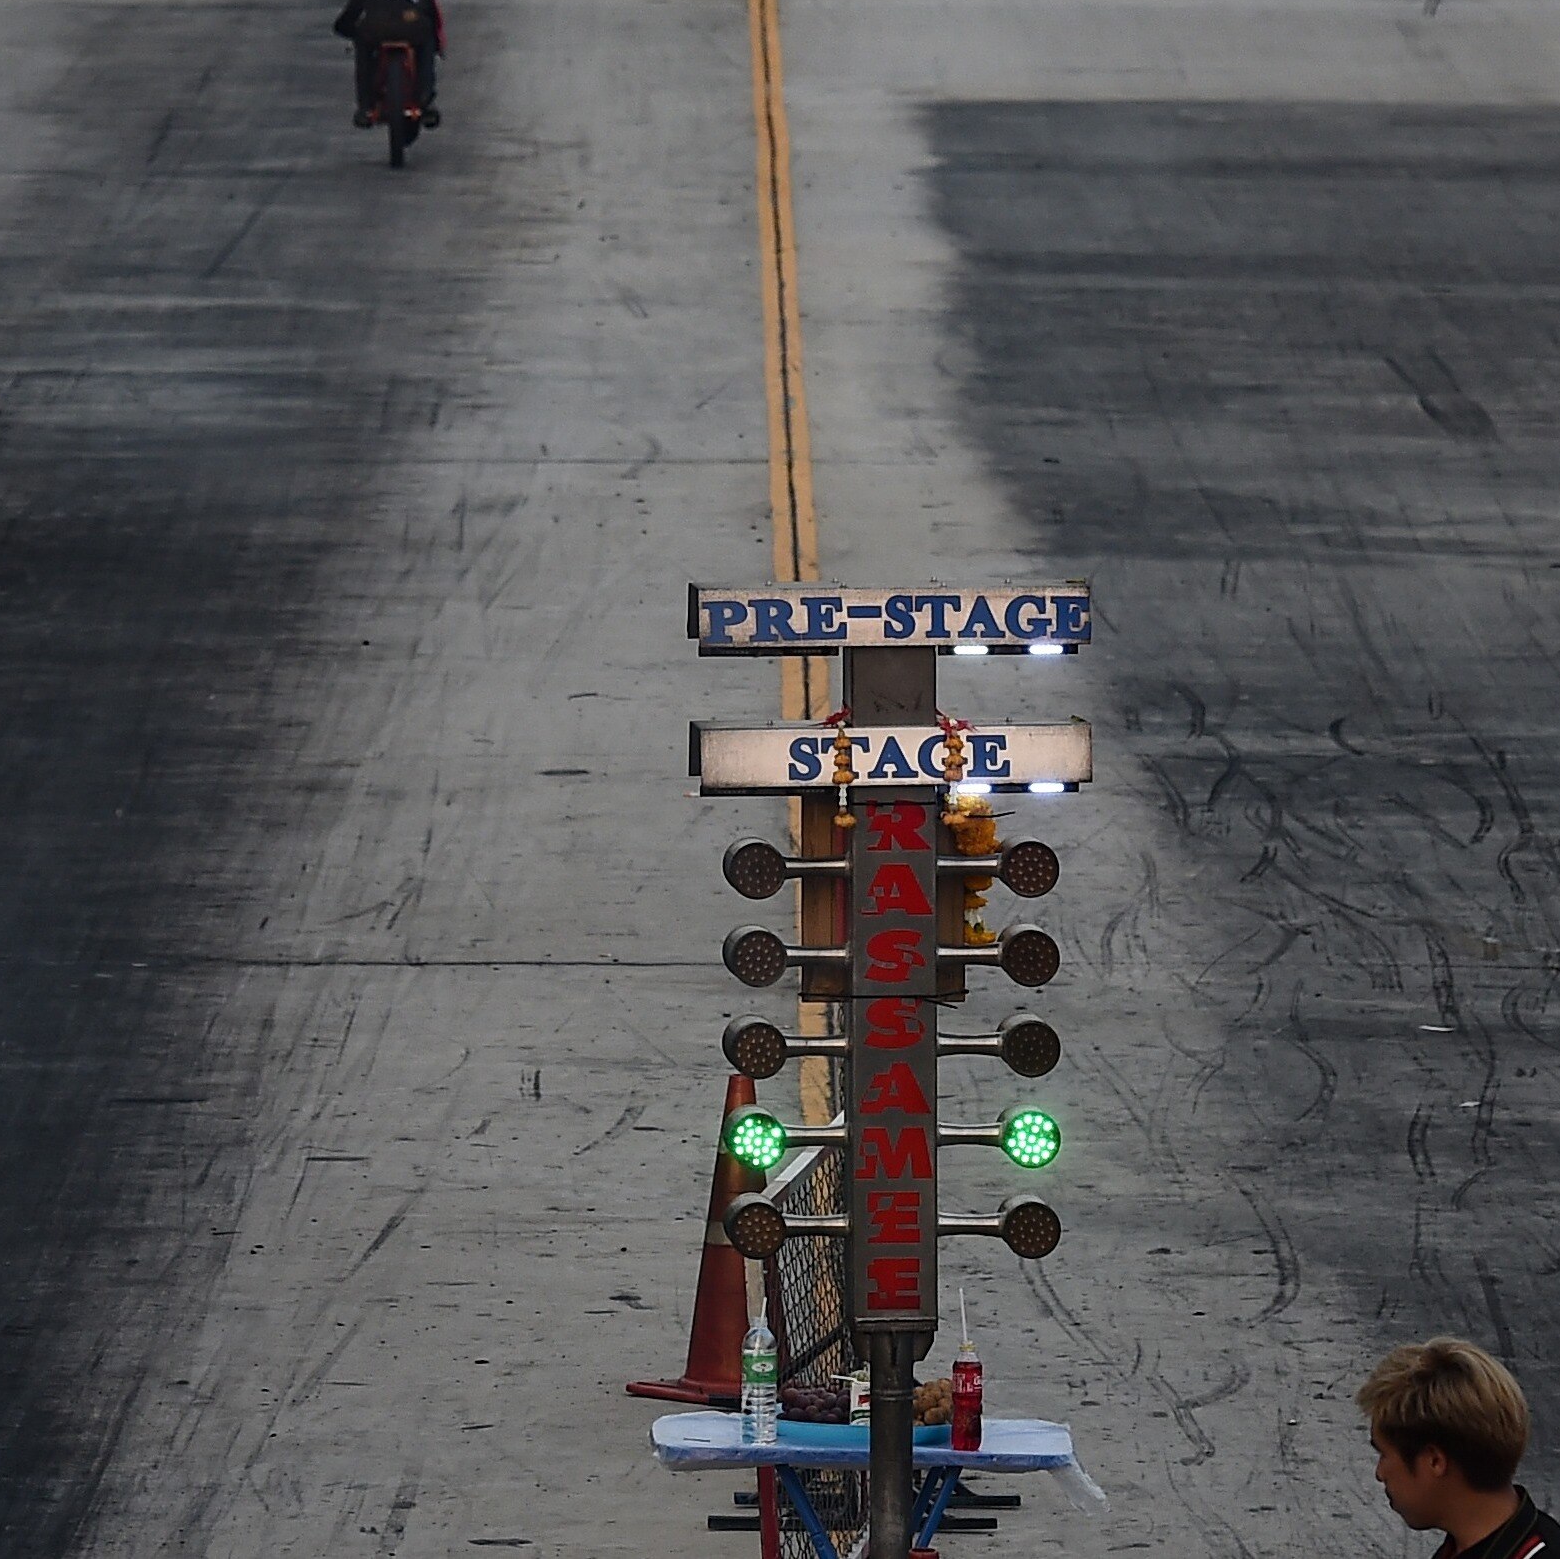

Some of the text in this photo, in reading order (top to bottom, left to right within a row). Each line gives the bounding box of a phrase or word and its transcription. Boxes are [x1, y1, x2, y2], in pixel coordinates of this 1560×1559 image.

[701, 594, 1092, 645] PRE-STAGE
[788, 734, 1011, 781] STAGE
[854, 800, 934, 1311] RASSAMEE
